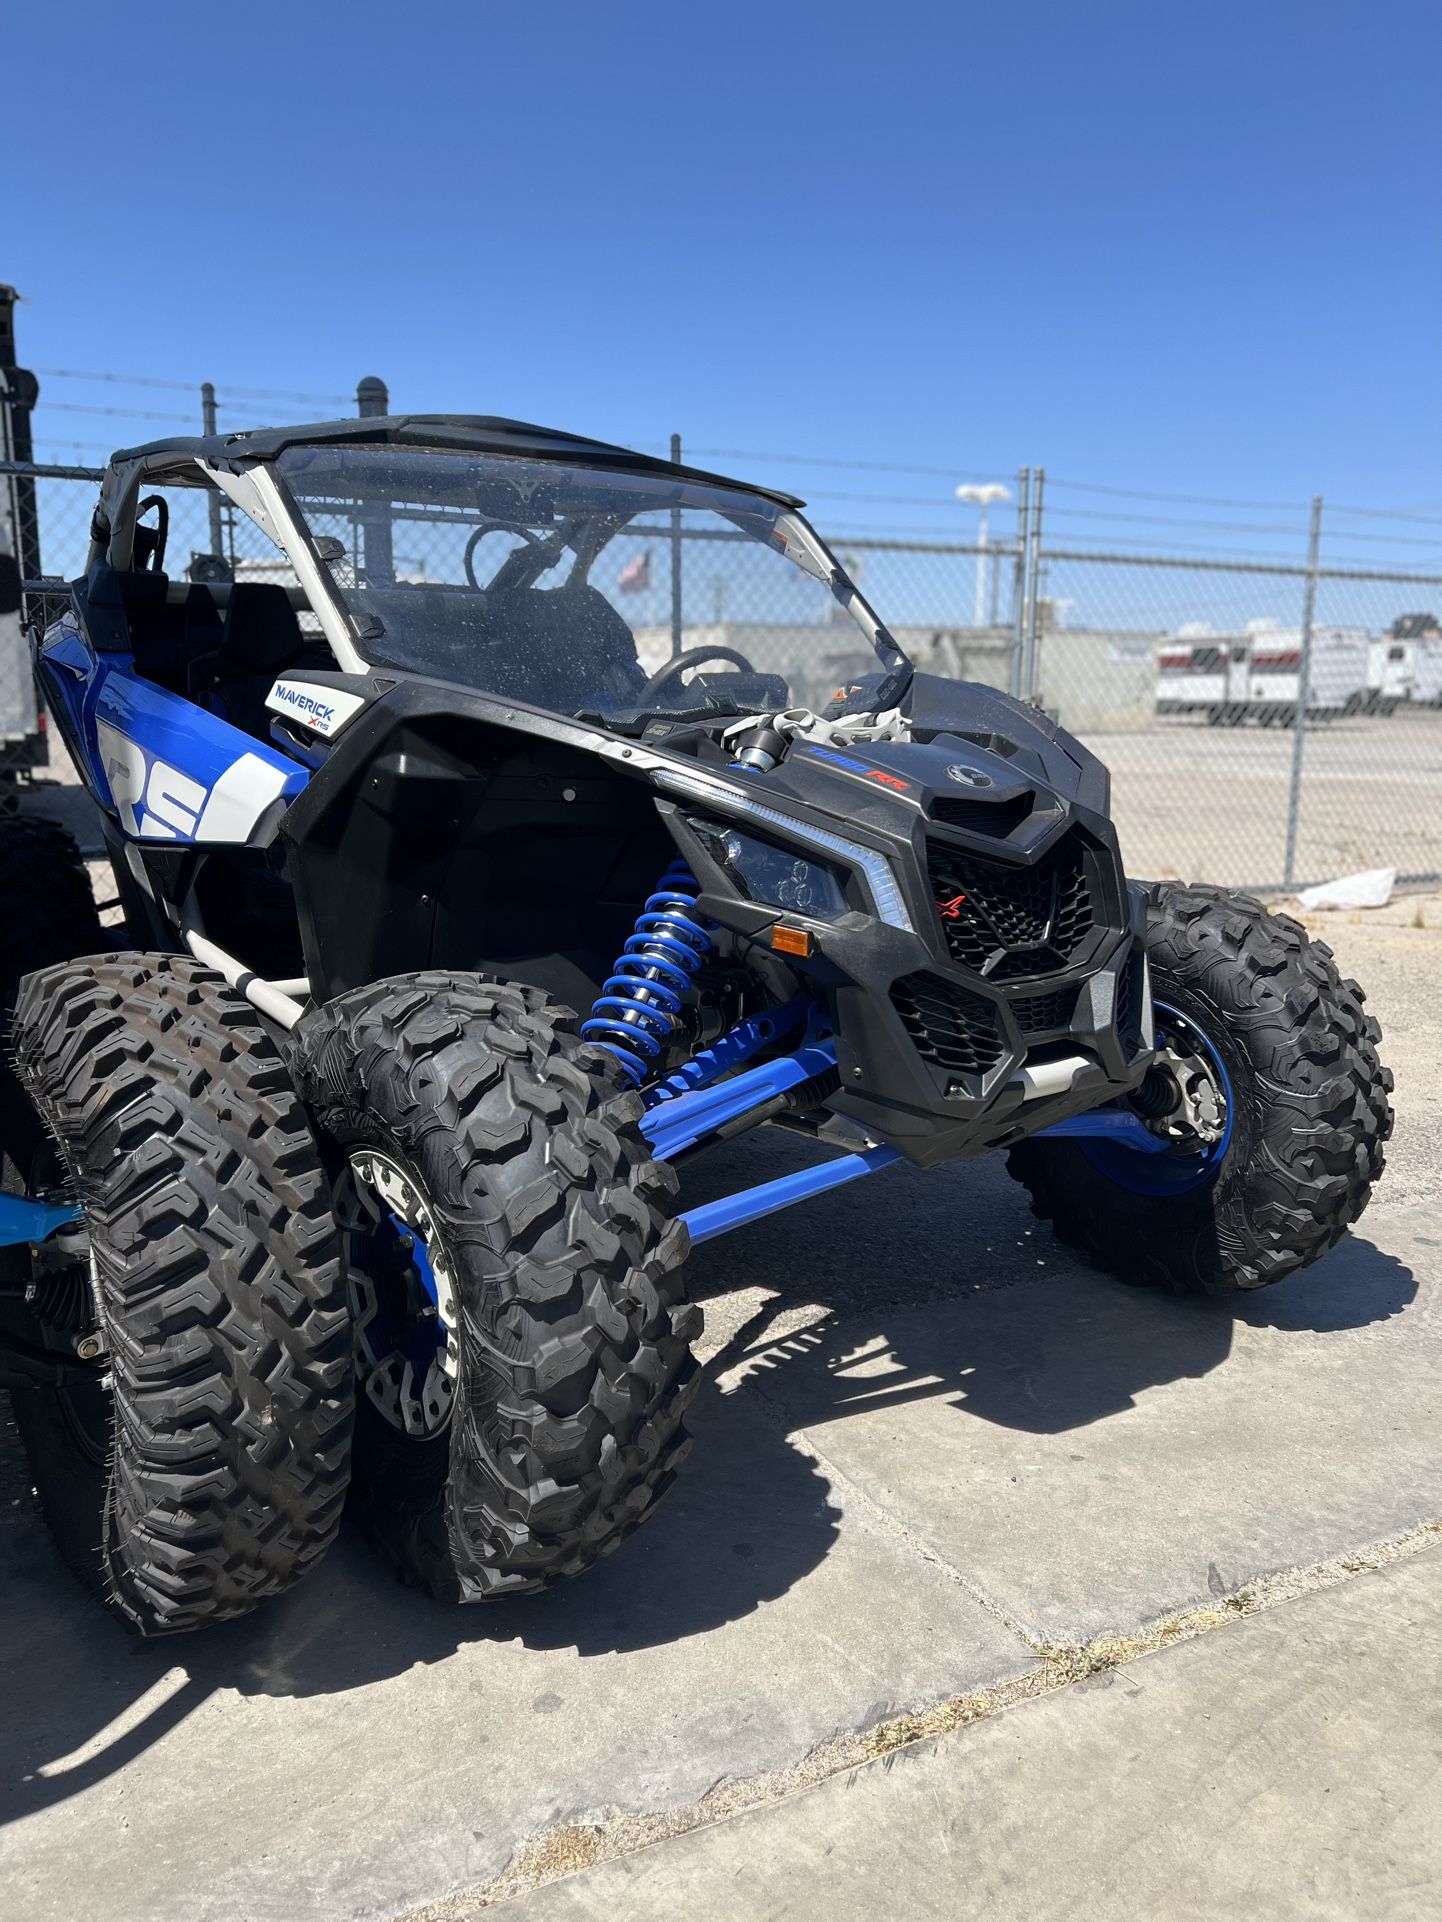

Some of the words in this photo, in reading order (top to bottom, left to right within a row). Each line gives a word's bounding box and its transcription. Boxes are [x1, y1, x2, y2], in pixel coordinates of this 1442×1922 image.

[275, 684, 336, 722] MAVERICK
[807, 746, 872, 773] TURBO
[866, 770, 911, 791] RR
